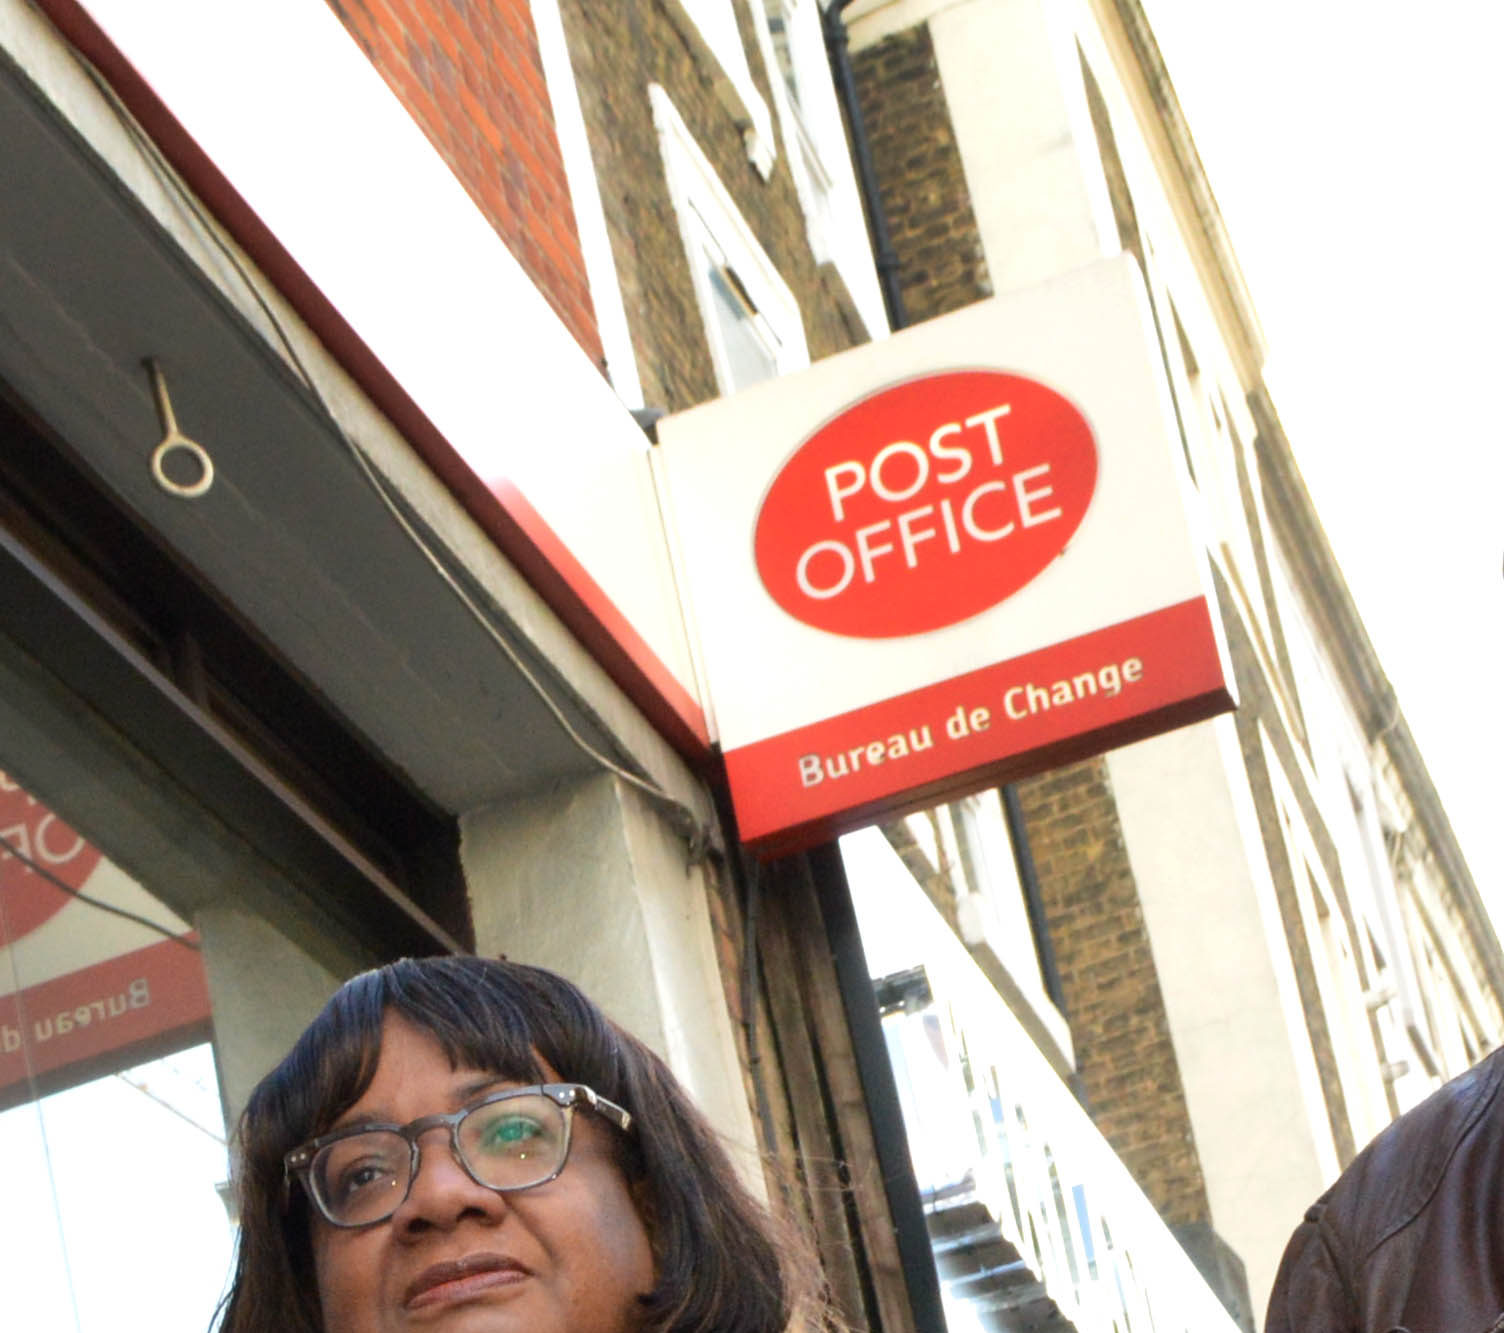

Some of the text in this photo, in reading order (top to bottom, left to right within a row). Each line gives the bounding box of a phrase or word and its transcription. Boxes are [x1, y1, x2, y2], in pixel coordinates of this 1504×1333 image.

[824, 404, 1012, 521] POST
[795, 463, 1064, 601] OFFICE
[798, 656, 1144, 789] Bureau de Change
